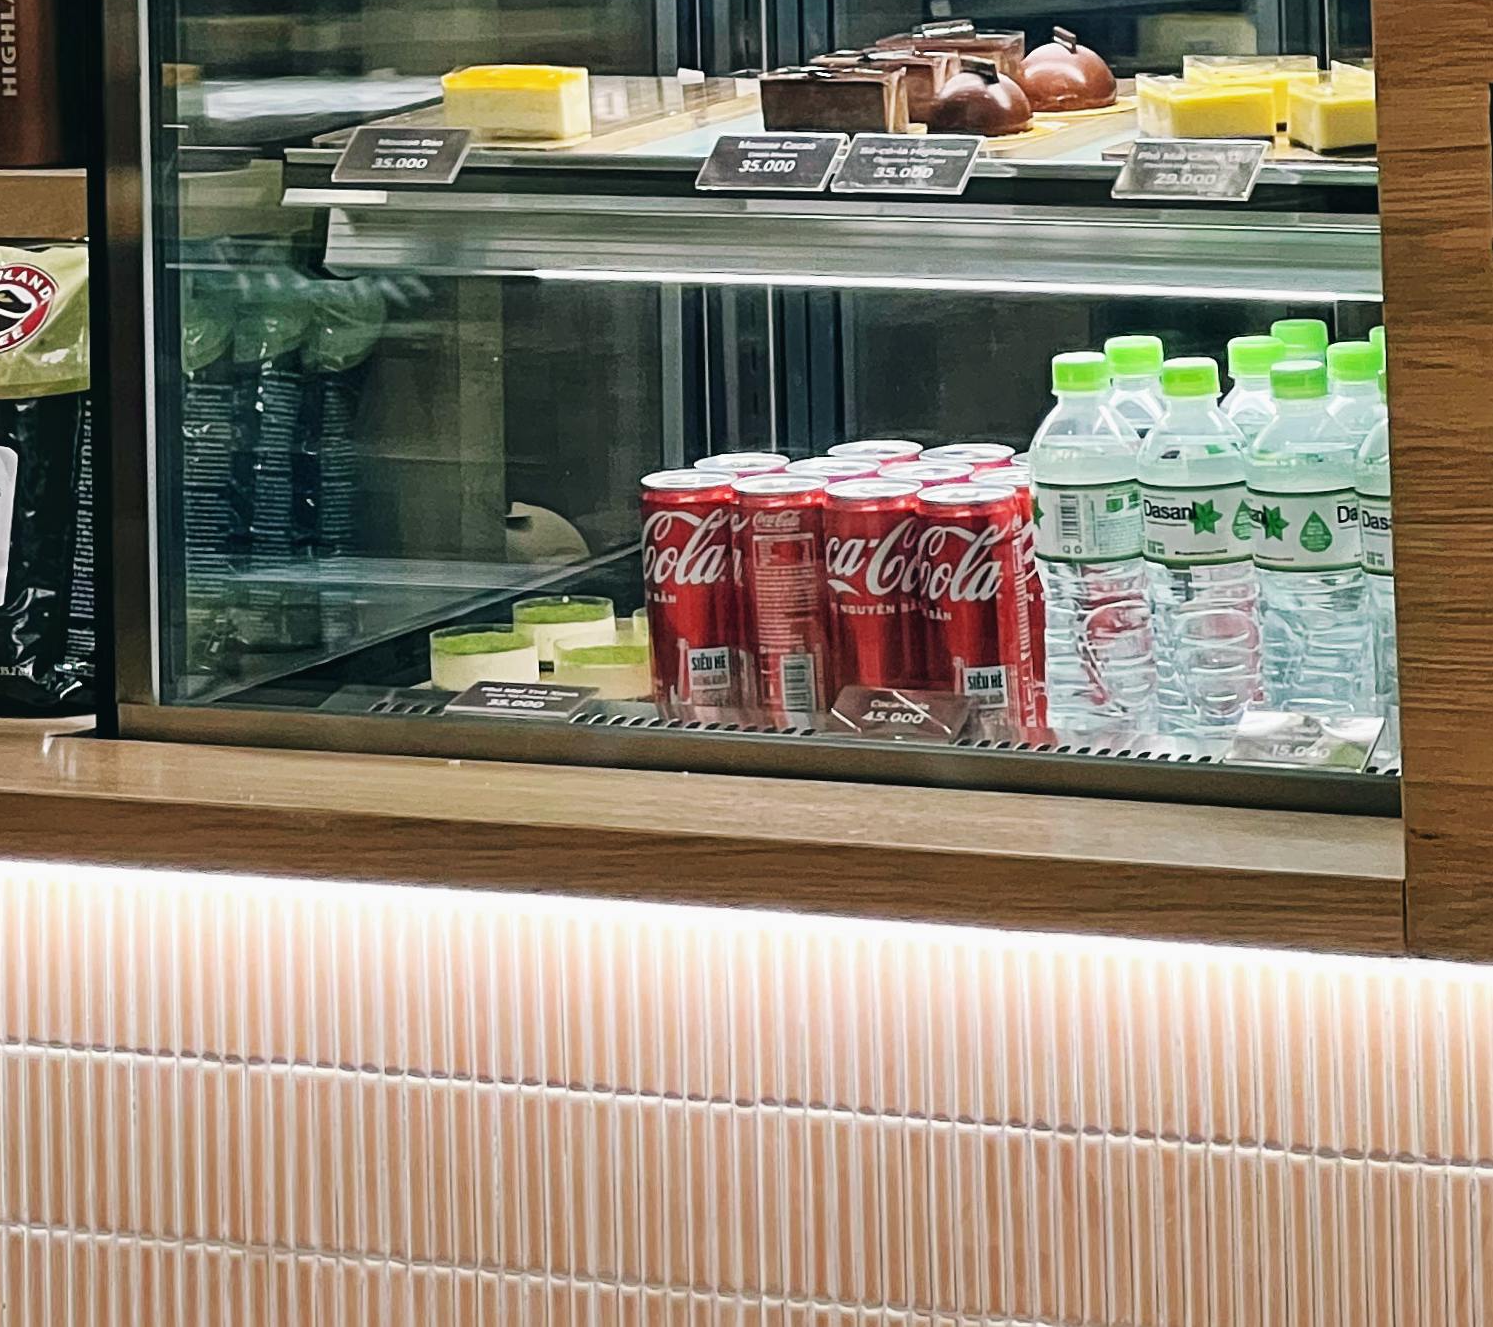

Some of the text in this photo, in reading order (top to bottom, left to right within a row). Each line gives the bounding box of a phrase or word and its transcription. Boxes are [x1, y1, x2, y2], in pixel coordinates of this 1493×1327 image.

[371, 158, 428, 169] 35.000
[738, 160, 796, 174] 35.000
[1153, 173, 1217, 185] 29.000
[840, 601, 896, 617] NGUYÊN
[862, 711, 924, 724] 45.000
